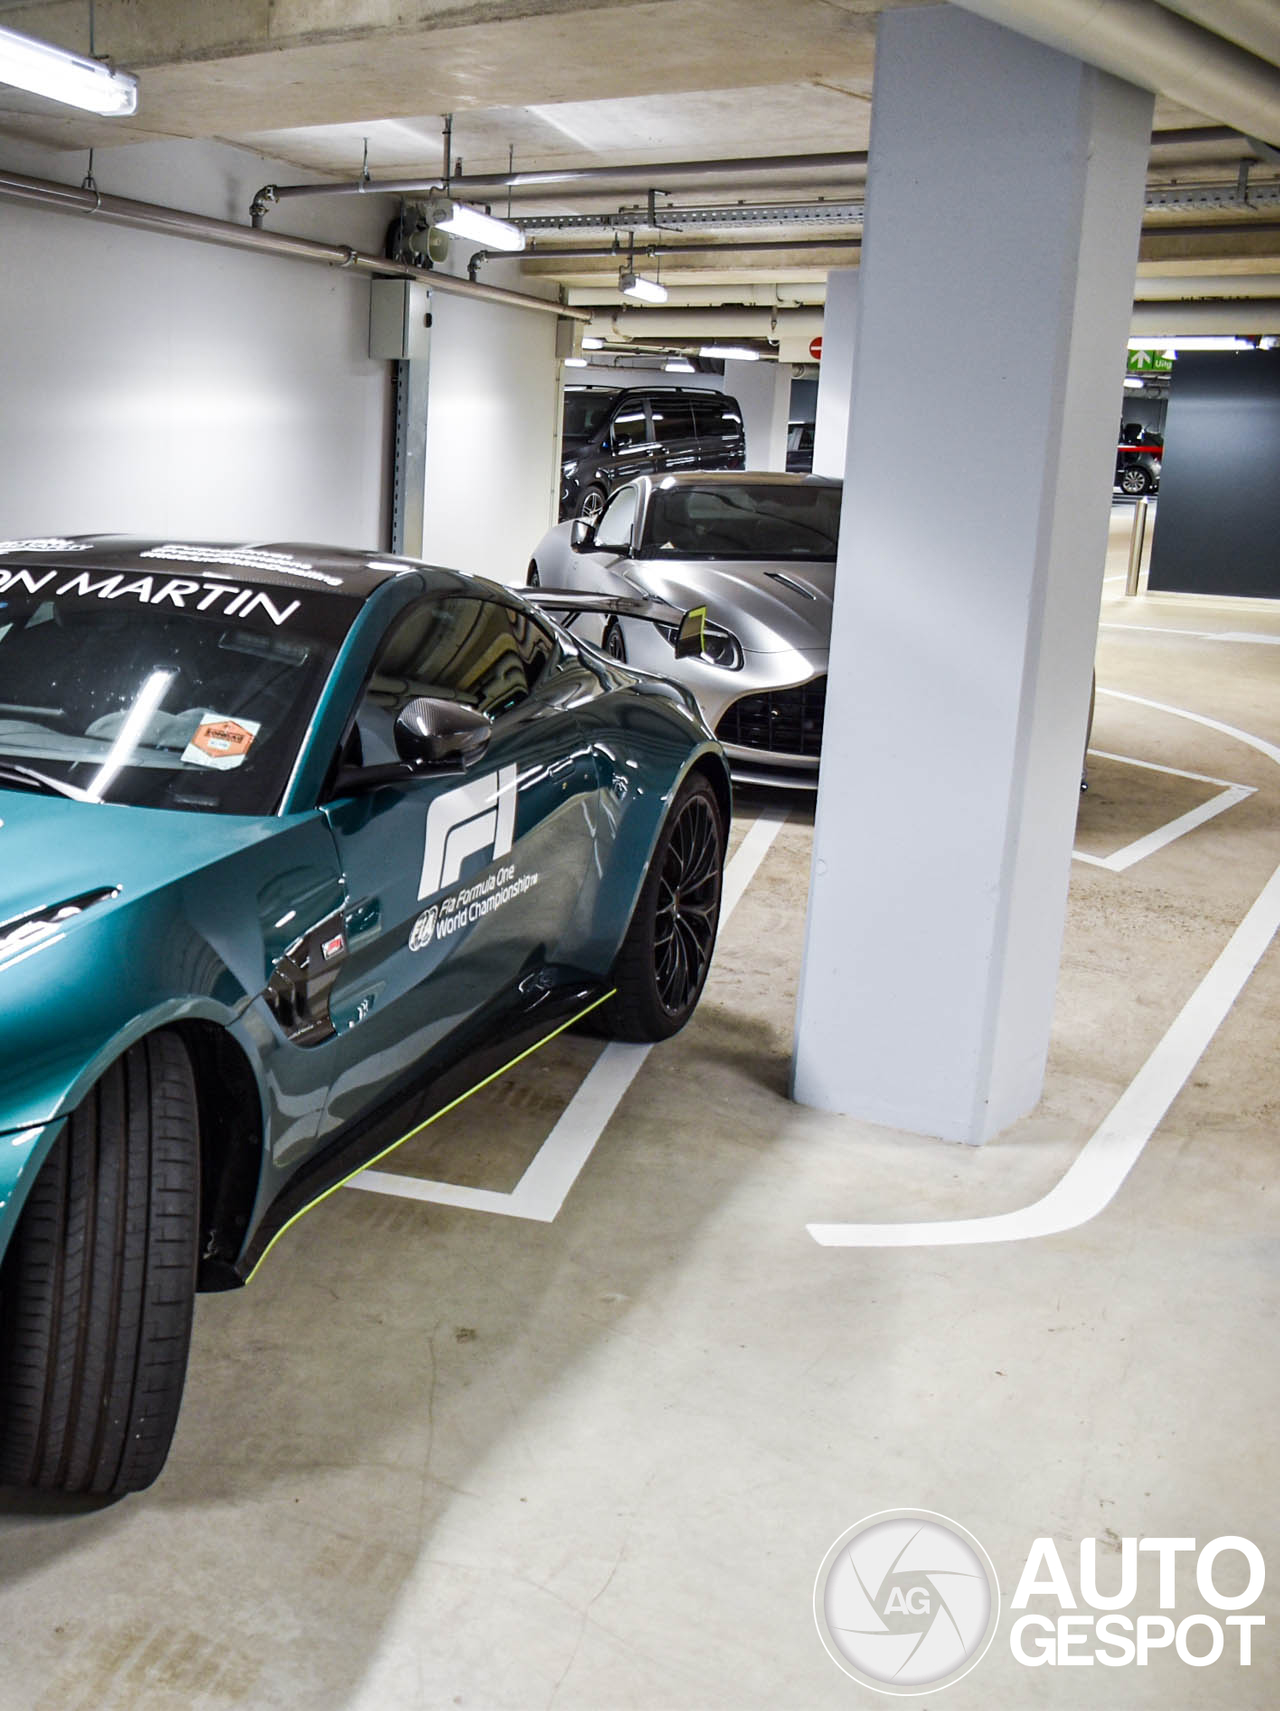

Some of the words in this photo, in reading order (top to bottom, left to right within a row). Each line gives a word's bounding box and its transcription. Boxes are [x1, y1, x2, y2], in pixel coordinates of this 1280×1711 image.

[56, 570, 301, 626] MARTIN
[456, 874, 496, 909] Formula
[496, 864, 515, 887] One
[436, 907, 468, 940] World
